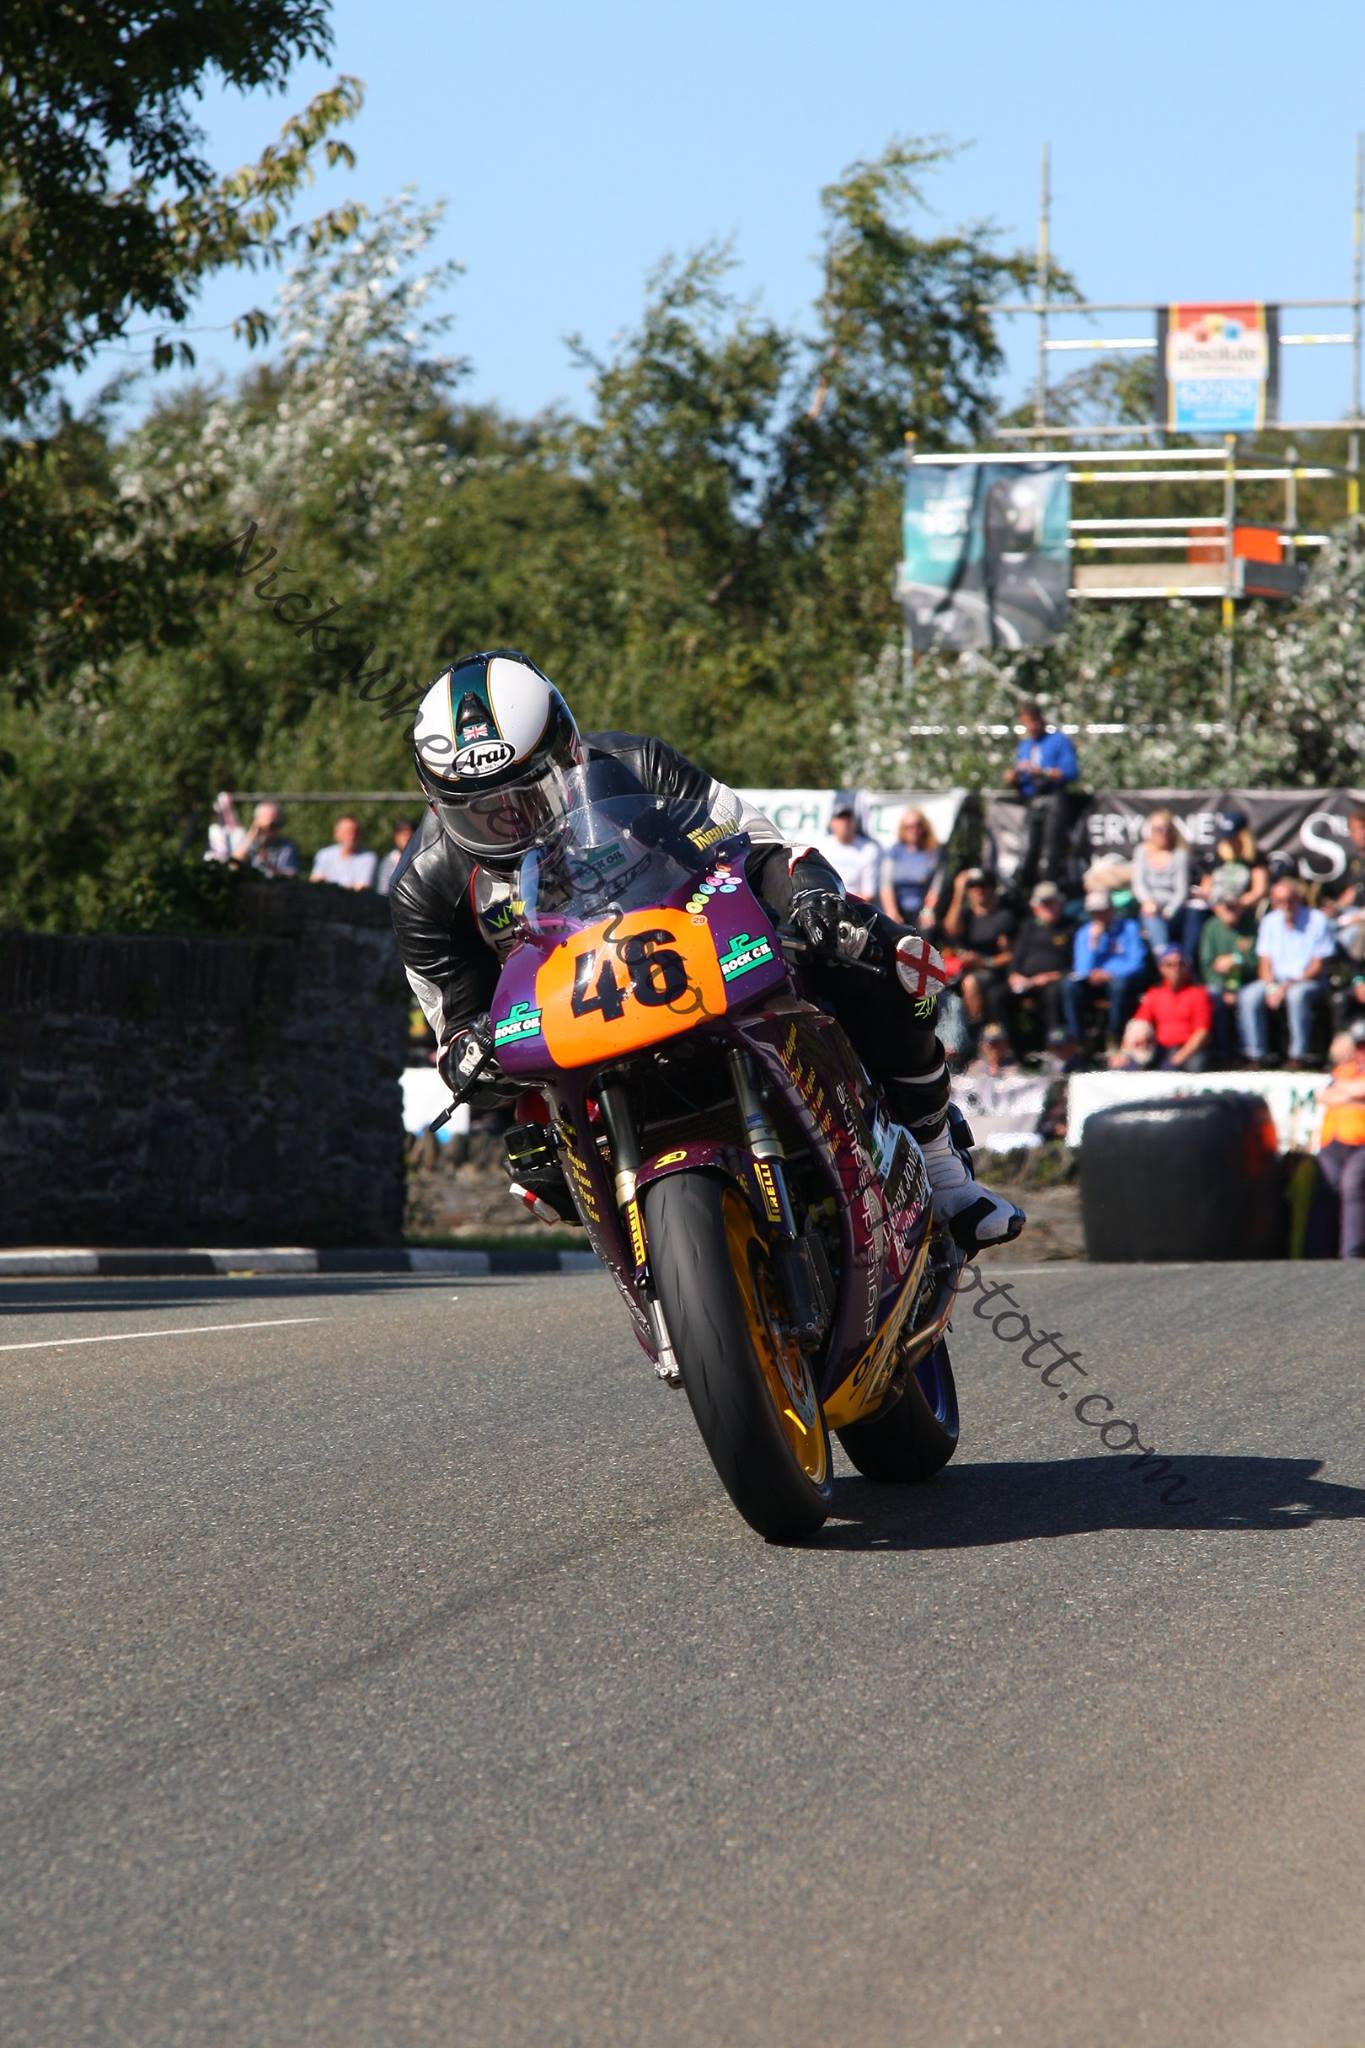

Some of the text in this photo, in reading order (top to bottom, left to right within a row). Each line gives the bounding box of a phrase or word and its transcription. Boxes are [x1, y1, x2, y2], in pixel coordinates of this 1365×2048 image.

[456, 743, 507, 771] Arai
[721, 943, 771, 975] ROCK OIL
[570, 929, 688, 1022] 46
[495, 1017, 541, 1039] ROCK OIL
[754, 1162, 782, 1222] PIRELLI
